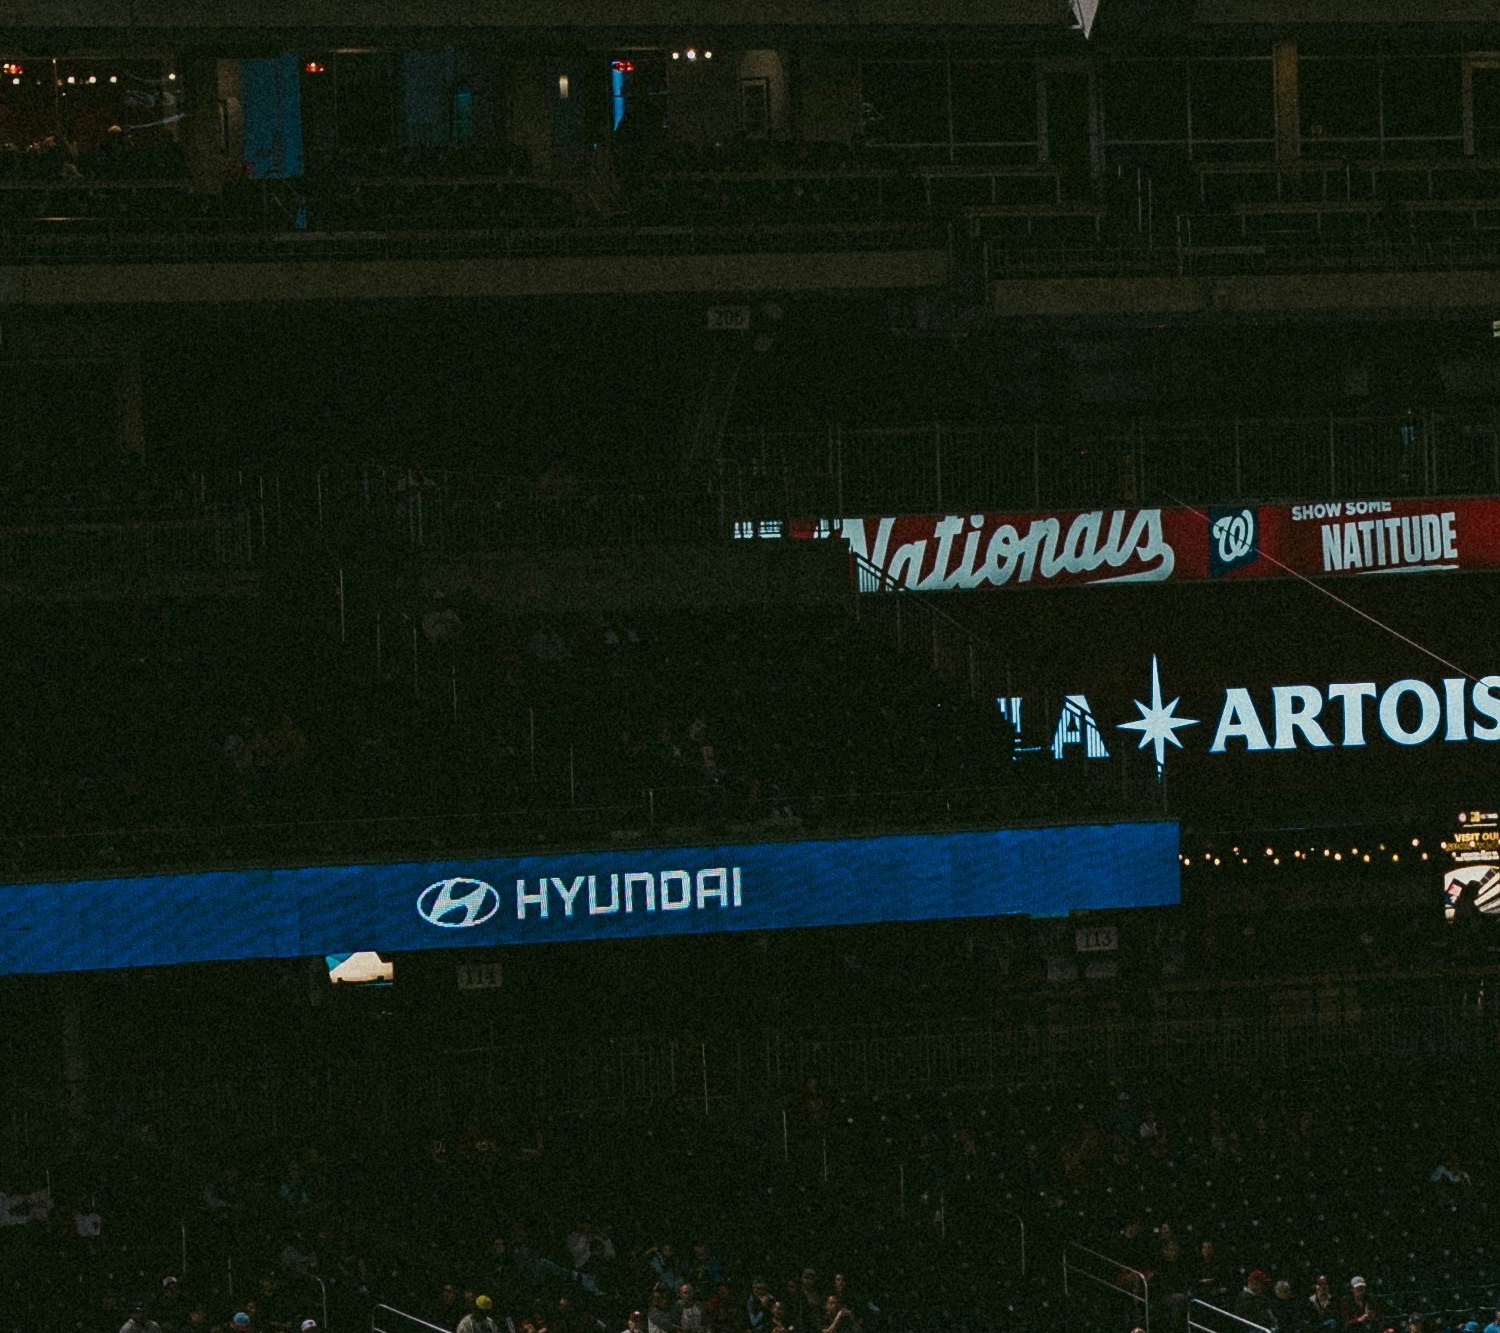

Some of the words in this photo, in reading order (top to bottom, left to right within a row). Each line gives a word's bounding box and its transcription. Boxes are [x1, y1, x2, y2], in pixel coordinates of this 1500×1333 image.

[1292, 503, 1339, 521] SHOW
[1320, 514, 1459, 572] NATITUDE
[1454, 832, 1479, 843] VISIT
[516, 867, 742, 920] HYUNDAI
